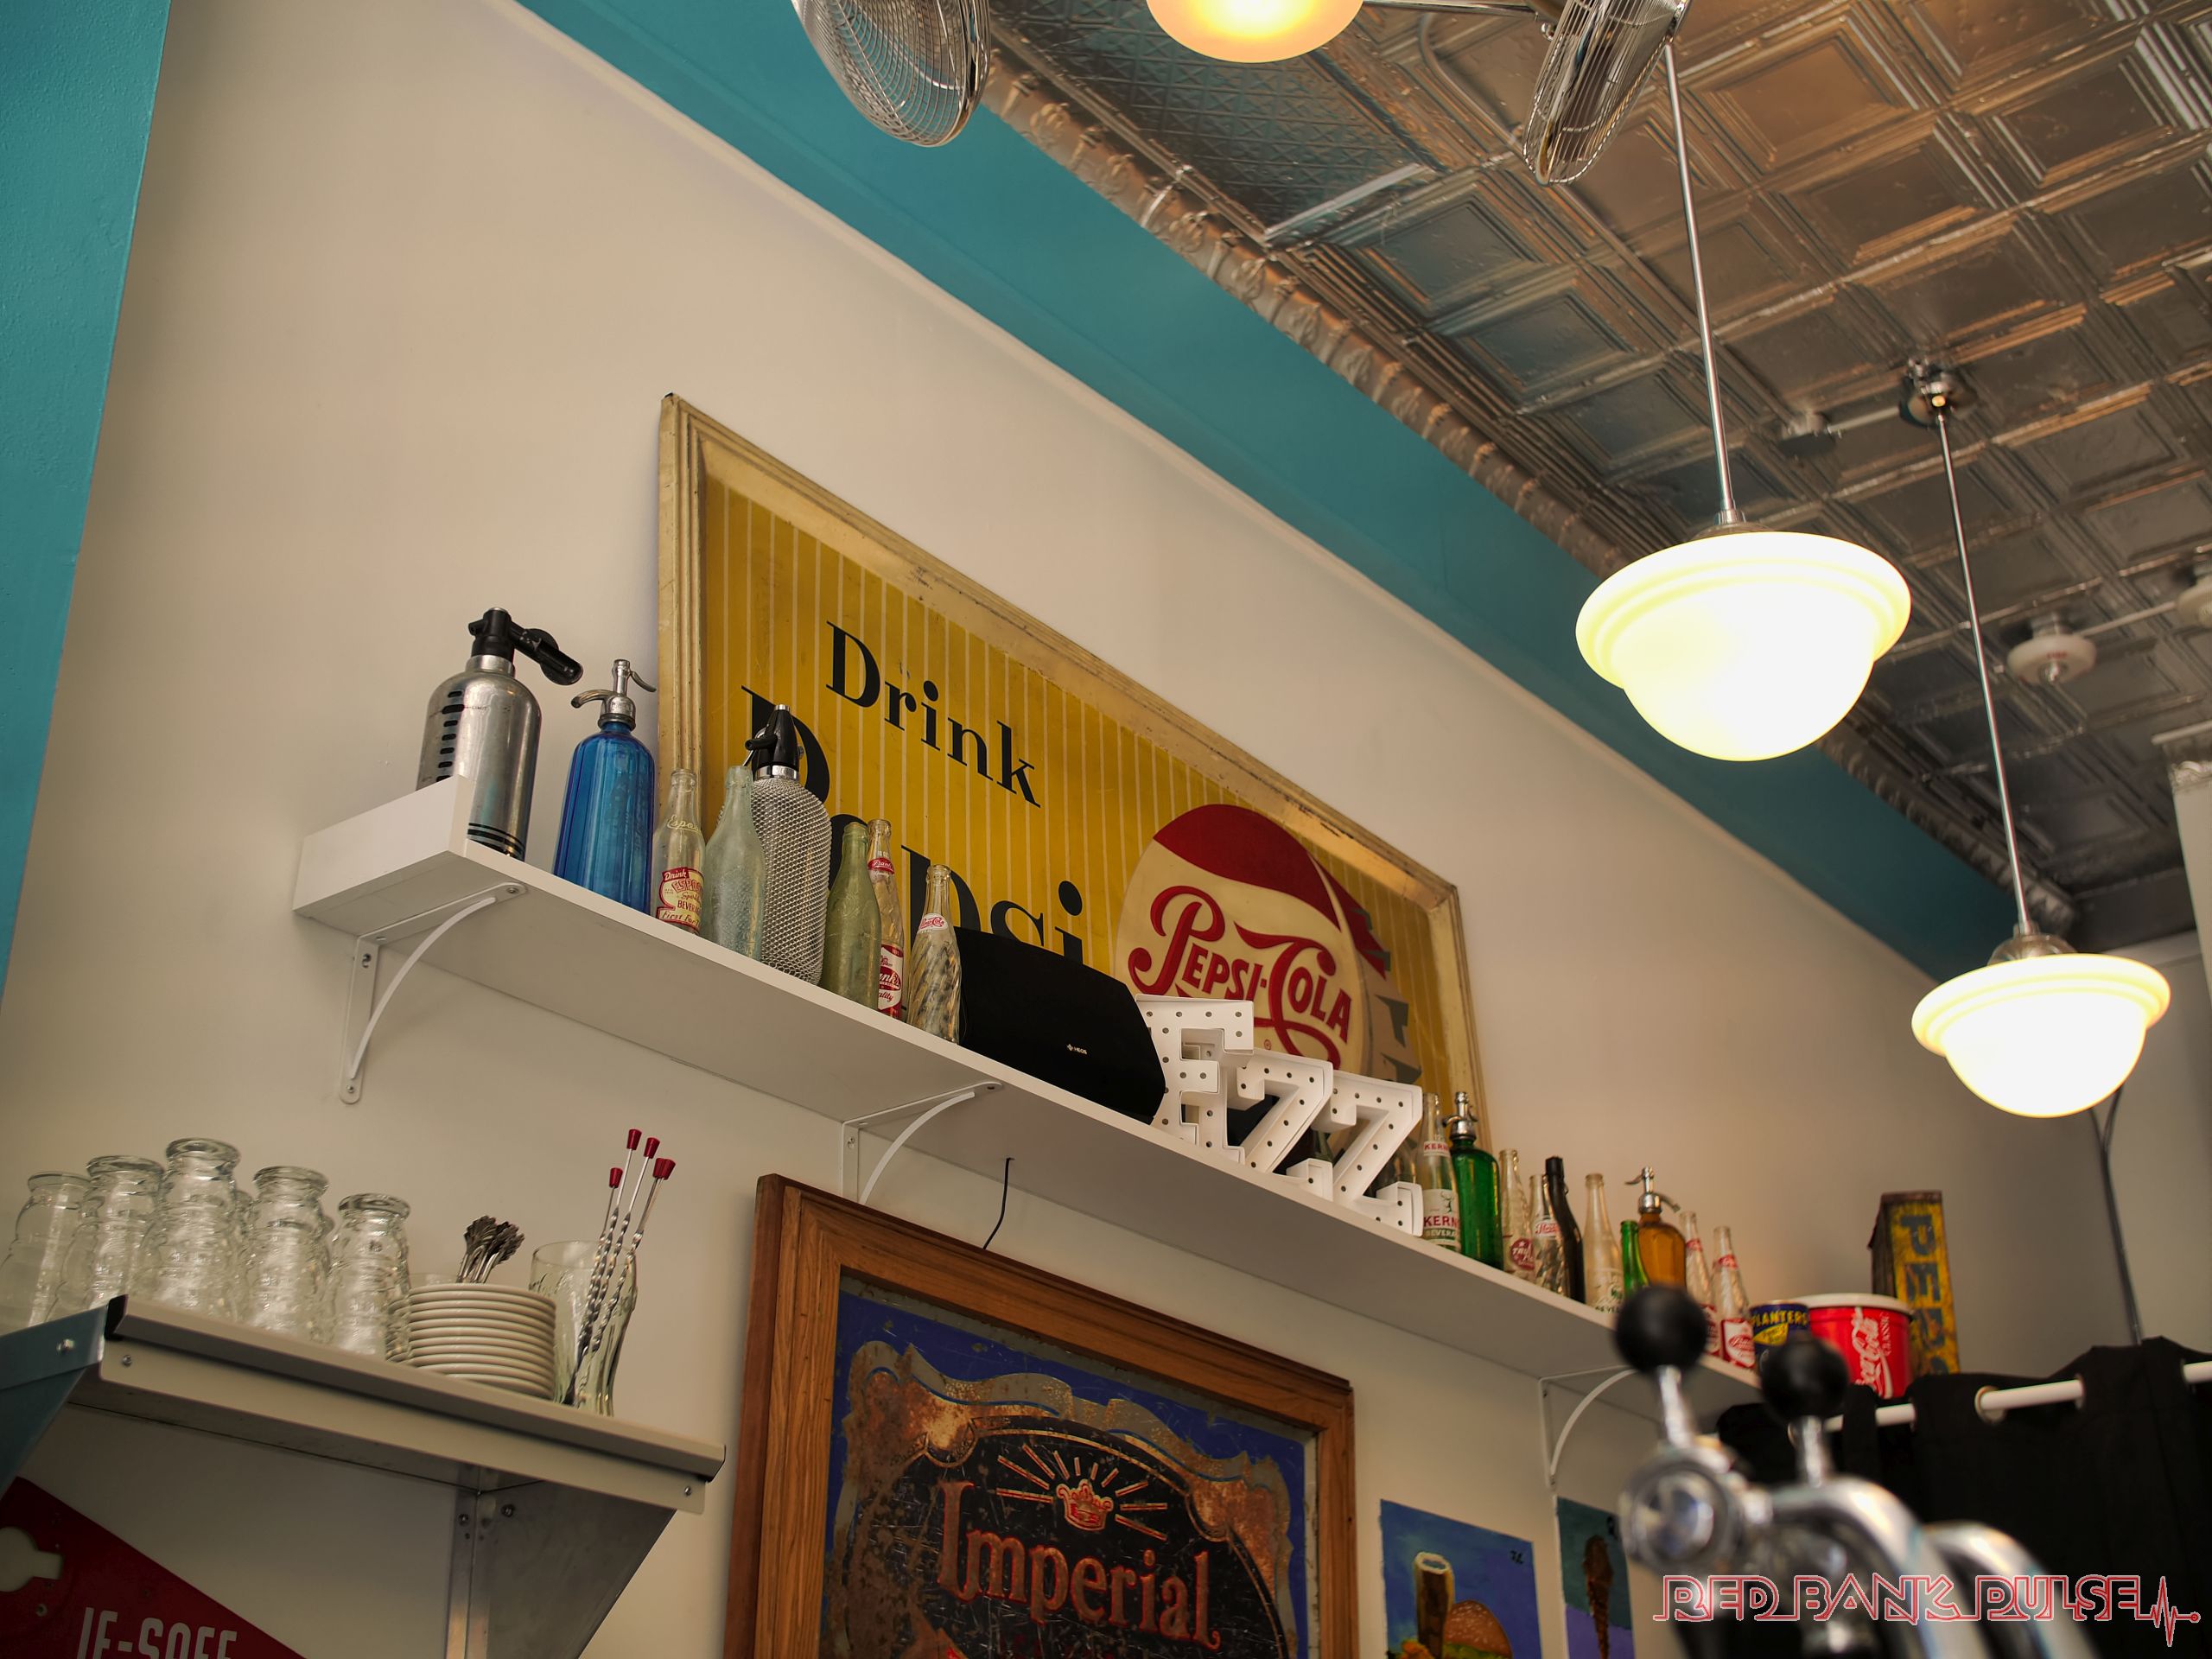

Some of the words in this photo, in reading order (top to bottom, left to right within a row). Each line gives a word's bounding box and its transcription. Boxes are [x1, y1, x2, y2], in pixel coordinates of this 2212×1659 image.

[826, 620, 1041, 809] Drink
[662, 911, 683, 920] First
[664, 868, 687, 880] Drink
[936, 1480, 1221, 1649] Imperial
